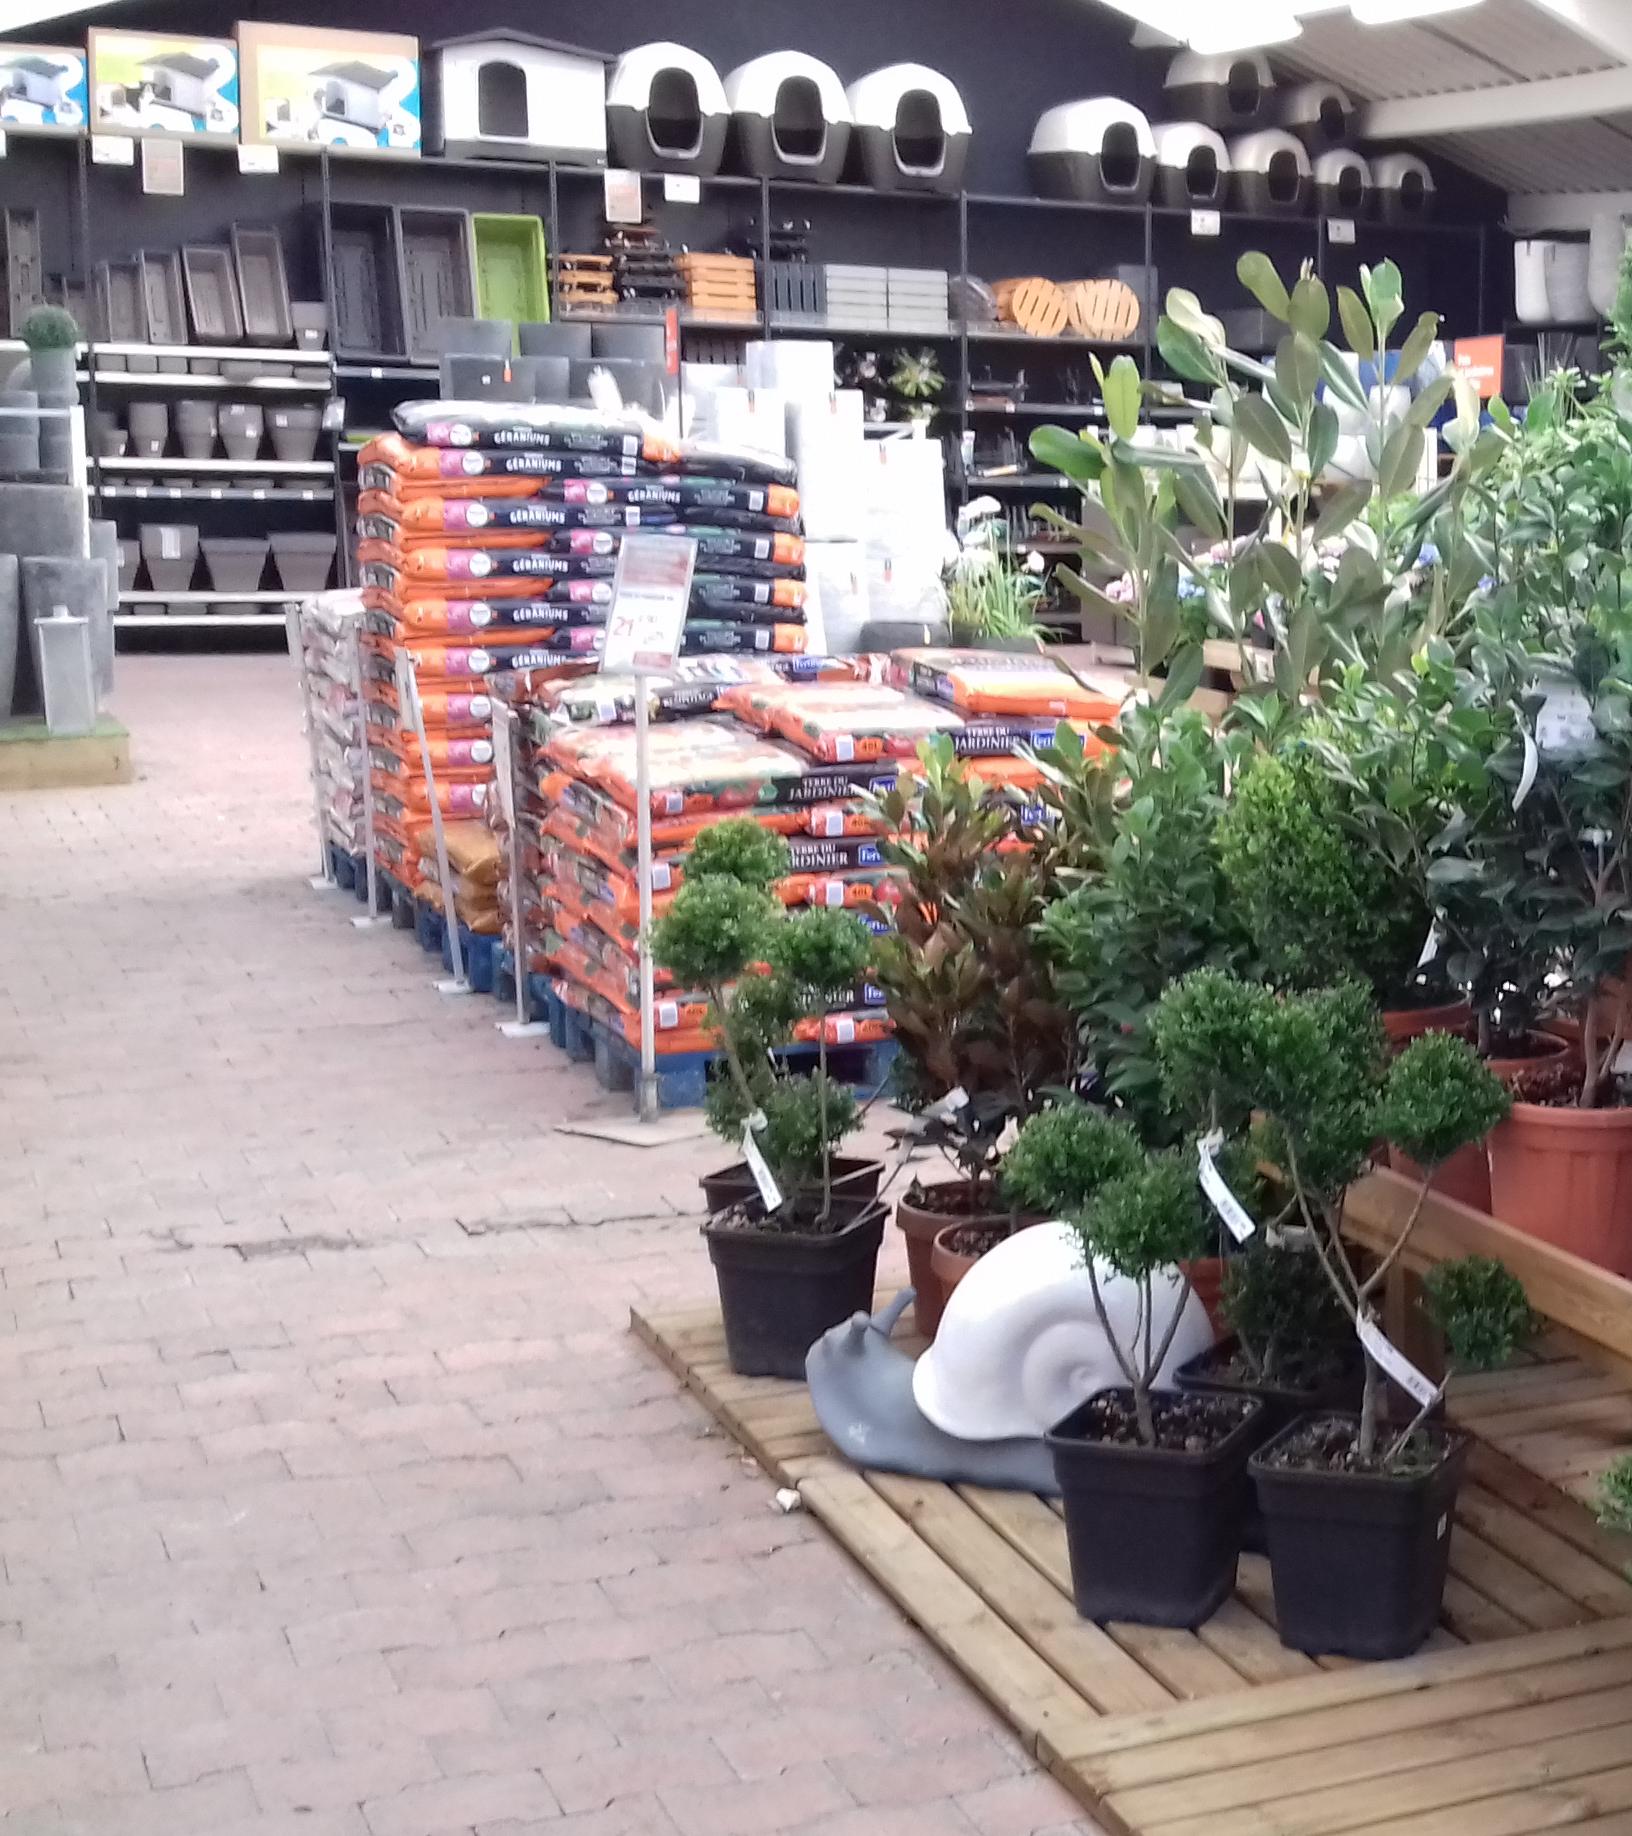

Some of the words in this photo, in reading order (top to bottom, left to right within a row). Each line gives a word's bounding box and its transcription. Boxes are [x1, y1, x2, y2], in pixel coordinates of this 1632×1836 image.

[493, 431, 551, 447] GÉRANIUMS
[505, 457, 562, 473] GÉRANIUMS
[627, 488, 681, 503] GÉRANIUMS
[509, 509, 566, 524] GÉRANIUMS
[512, 557, 569, 573] GÉRANIUMS
[512, 606, 569, 622] GÉRANIUMS
